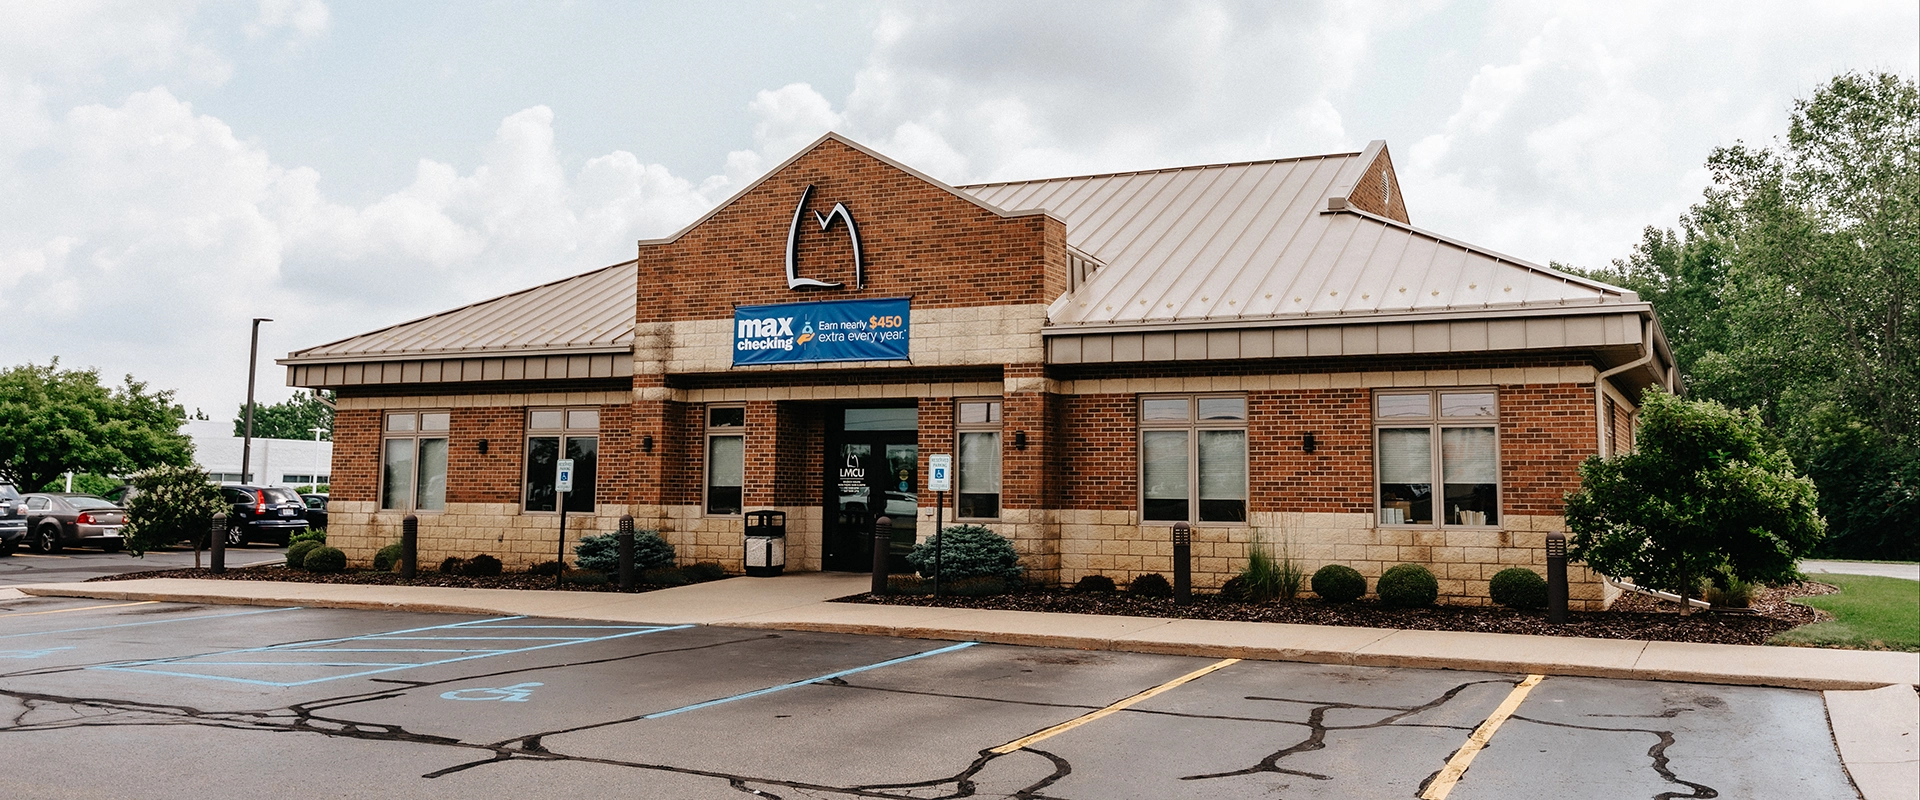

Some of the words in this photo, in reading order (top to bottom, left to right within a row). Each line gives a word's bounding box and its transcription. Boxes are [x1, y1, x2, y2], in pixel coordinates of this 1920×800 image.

[738, 317, 794, 339] max
[818, 320, 839, 331] Earn
[840, 320, 868, 331] nearly
[869, 315, 903, 330] $450
[737, 337, 794, 351] checking
[818, 331, 845, 343] extra
[847, 331, 877, 344] every
[839, 468, 865, 478] LMCU
